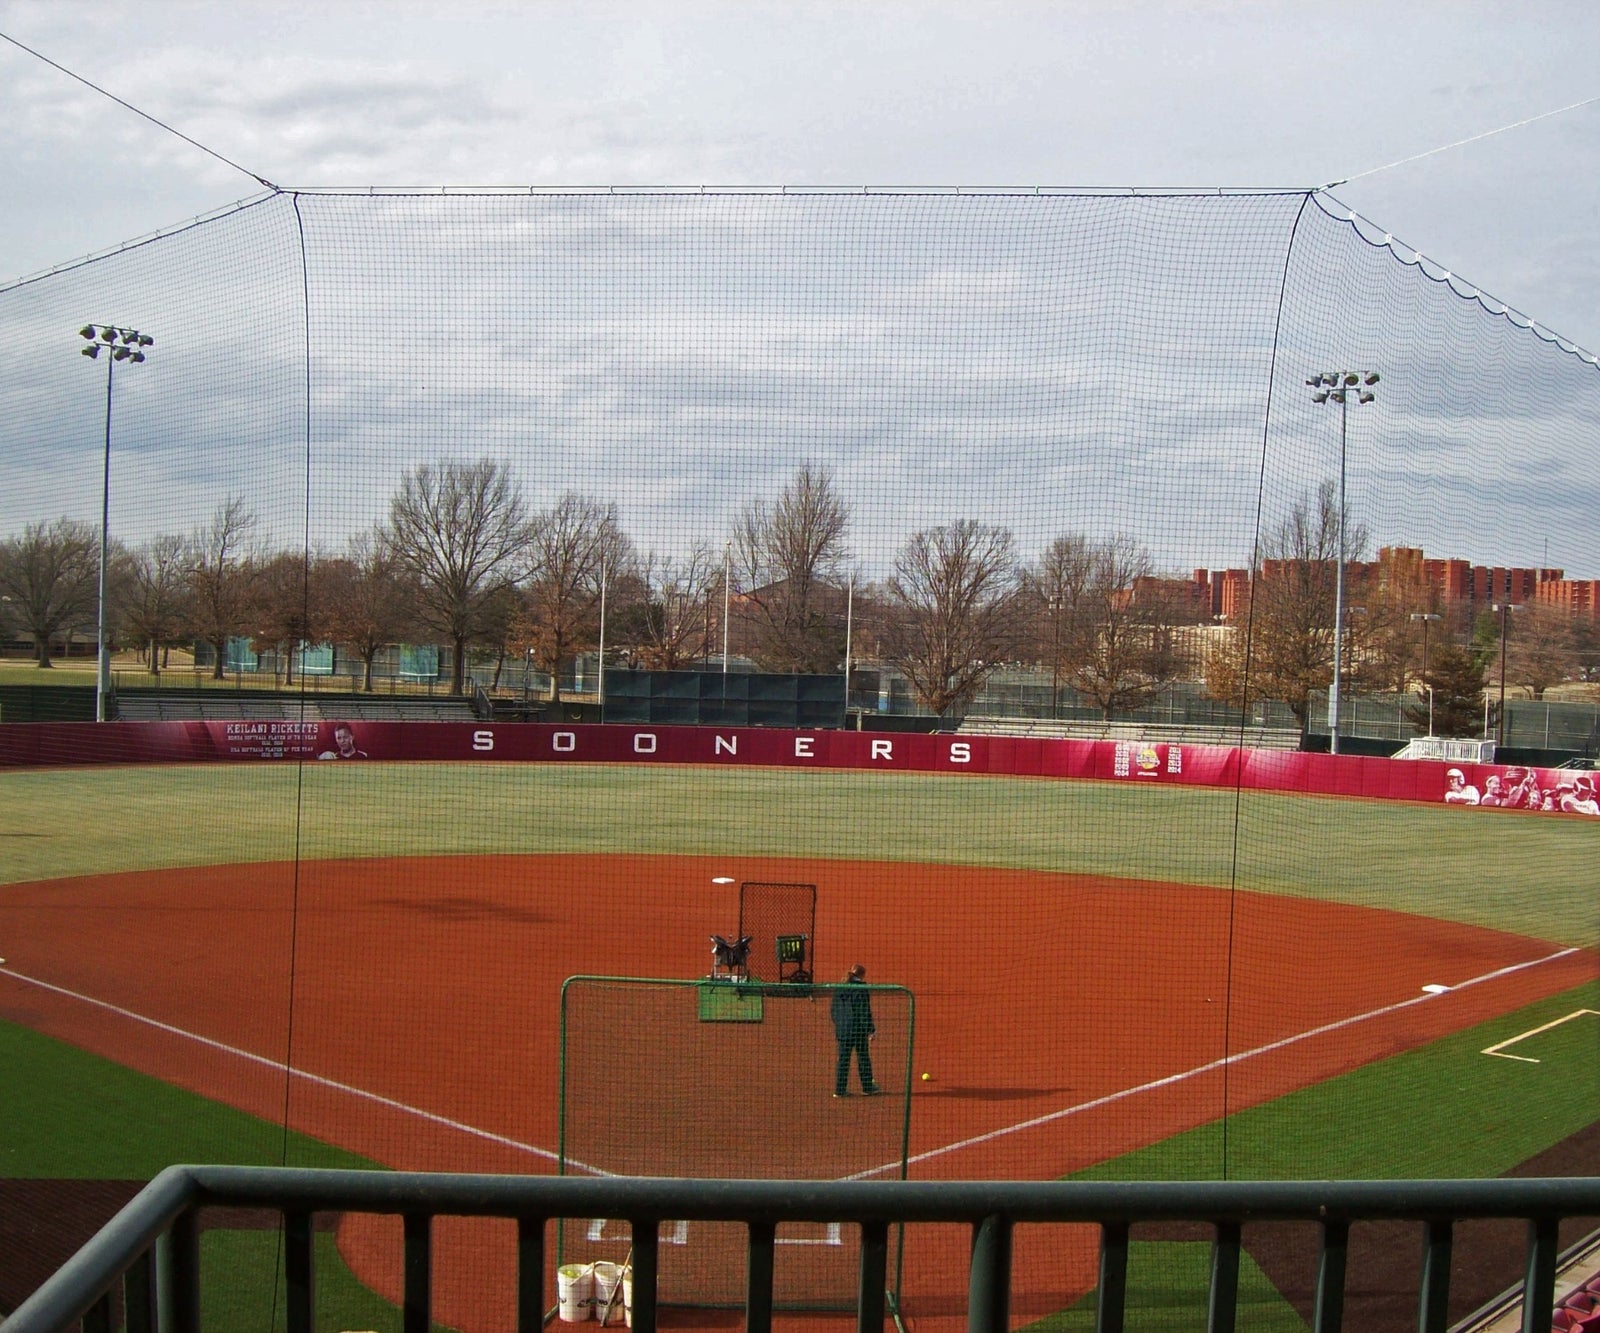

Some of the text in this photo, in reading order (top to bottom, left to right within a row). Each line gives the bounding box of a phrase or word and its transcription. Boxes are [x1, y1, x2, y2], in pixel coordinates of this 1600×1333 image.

[226, 723, 319, 734] KEILANI RICKETTS
[472, 730, 971, 763] SOONERS
